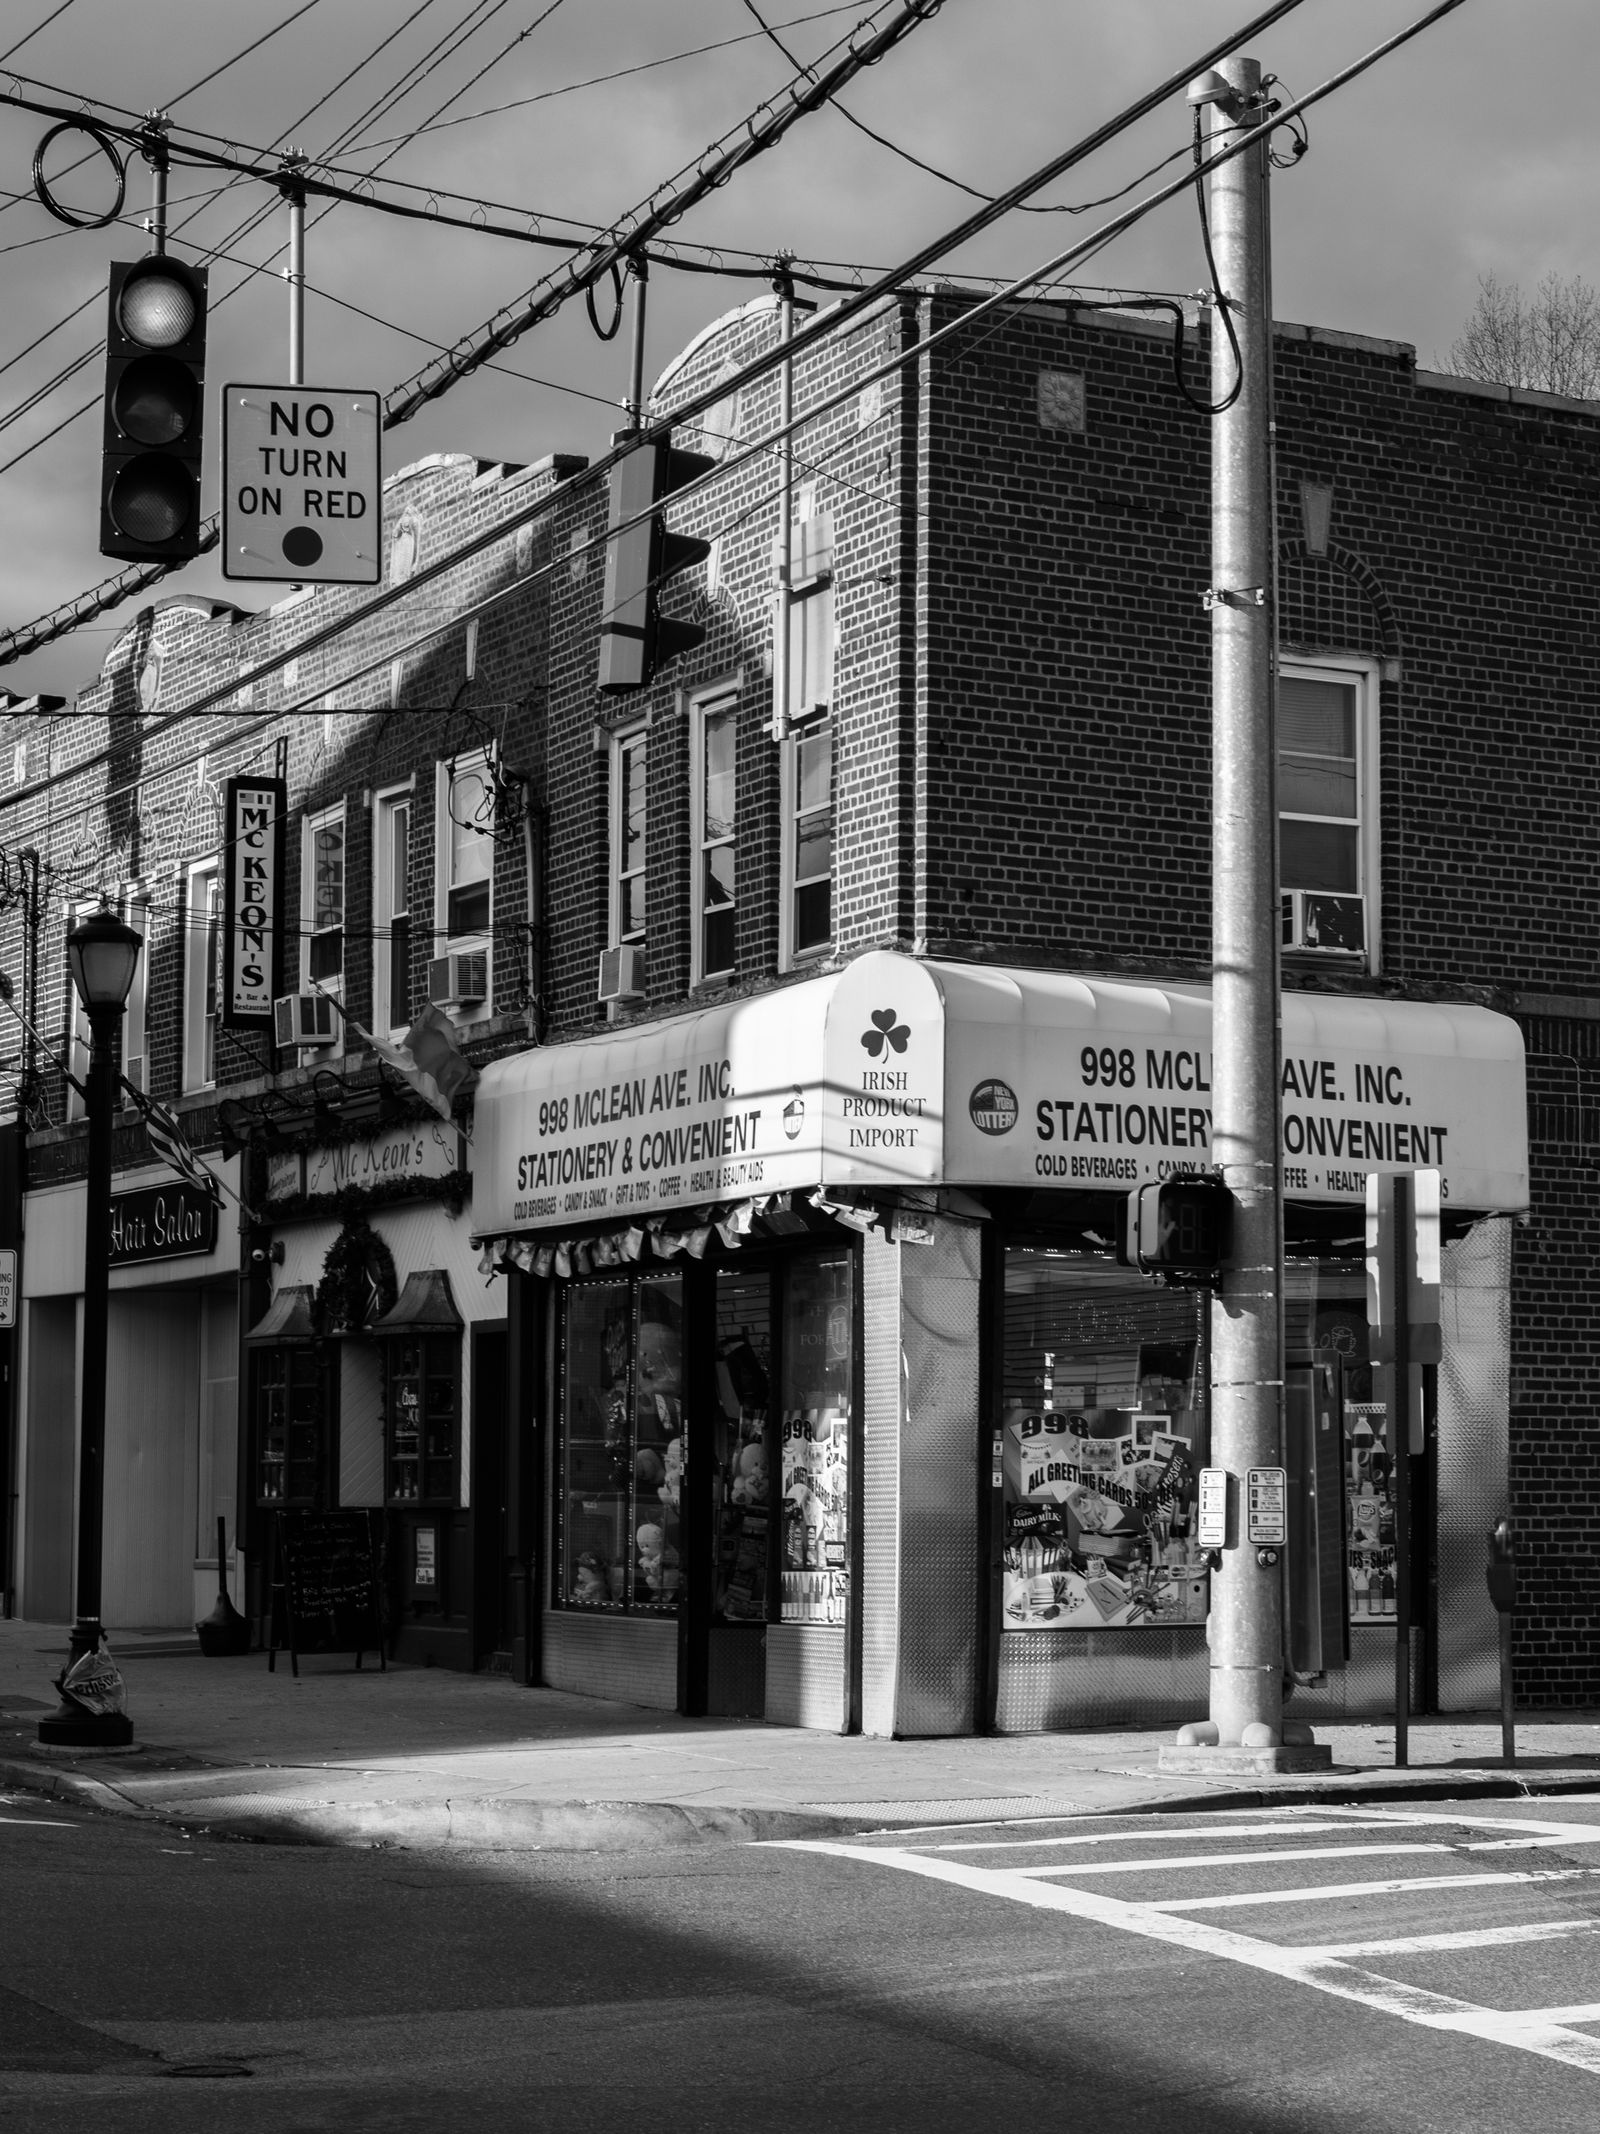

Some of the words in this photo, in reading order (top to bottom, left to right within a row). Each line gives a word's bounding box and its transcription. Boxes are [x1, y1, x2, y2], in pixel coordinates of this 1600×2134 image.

[270, 401, 334, 438] NO
[258, 446, 347, 479] TURN
[238, 486, 282, 516] ON
[304, 488, 367, 520] RED
[234, 1003, 270, 1012] Restaurant
[246, 993, 259, 1001] Bar
[862, 1071, 909, 1091] IRISH
[994, 1085, 1012, 1097] NEW
[1080, 1046, 1136, 1088] 998
[1282, 1058, 1345, 1102] AVE.
[1355, 1063, 1411, 1106] INC.
[539, 1097, 569, 1137] 998
[574, 1078, 647, 1130] MCLEAN
[650, 1068, 691, 1114] AVE.
[698, 1059, 735, 1104] INC.
[843, 1098, 927, 1118] PRODUCT
[994, 1096, 1016, 1111] YORK
[972, 1110, 1017, 1129] LOTTERY
[517, 1140, 619, 1191] STATIONERY
[622, 1136, 633, 1174] &
[639, 1110, 762, 1172] CONVENIENT
[849, 1128, 919, 1148] IMPORT
[1282, 1114, 1448, 1166] ONVENIENT
[1035, 1154, 1068, 1178] COLD
[1071, 1154, 1138, 1180] BEVERAGES
[1327, 1170, 1367, 1193] HEALTH
[514, 1202, 528, 1221] COLD
[528, 1196, 557, 1218] BEVERAGES
[564, 1193, 583, 1213] CANDY
[588, 1187, 608, 1208] SNACK
[616, 1184, 629, 1204] GIFT
[635, 1180, 650, 1201] TOYS
[659, 1175, 682, 1197] COFFEE
[690, 1171, 714, 1192] HEALTH
[723, 1163, 746, 1188] BEAUTY
[748, 1161, 764, 1183] AIDS
[153, 1195, 202, 1247] Salon
[1021, 1412, 1089, 1441] 998
[1028, 1467, 1046, 1495] ALL
[1047, 1462, 1096, 1491] GREETING
[1097, 1475, 1133, 1508] CARDS
[1013, 1515, 1038, 1528] DAIRY
[1038, 1511, 1062, 1522] MILK
